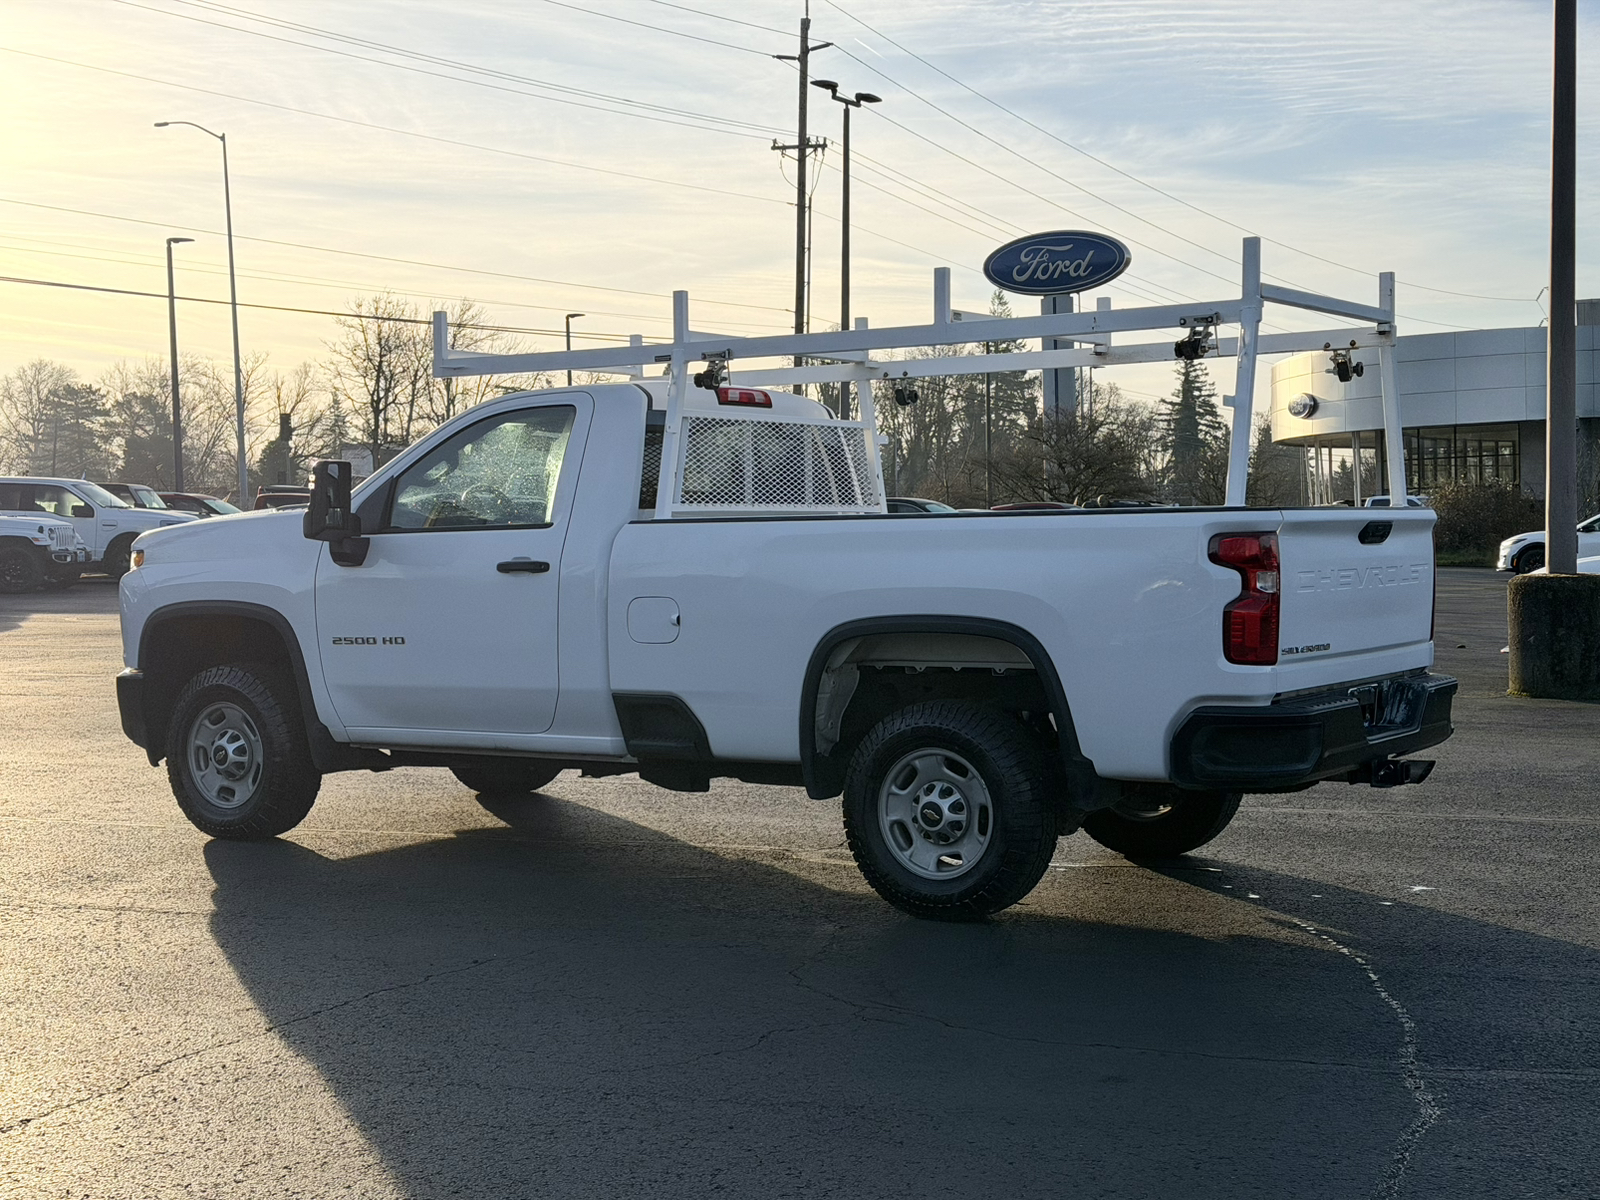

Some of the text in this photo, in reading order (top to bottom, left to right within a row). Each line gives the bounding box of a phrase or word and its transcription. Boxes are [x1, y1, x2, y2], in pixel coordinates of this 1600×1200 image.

[1012, 244, 1094, 282] Ford
[1297, 563, 1429, 593] CHEVROLET
[332, 636, 406, 645] 2500 HD
